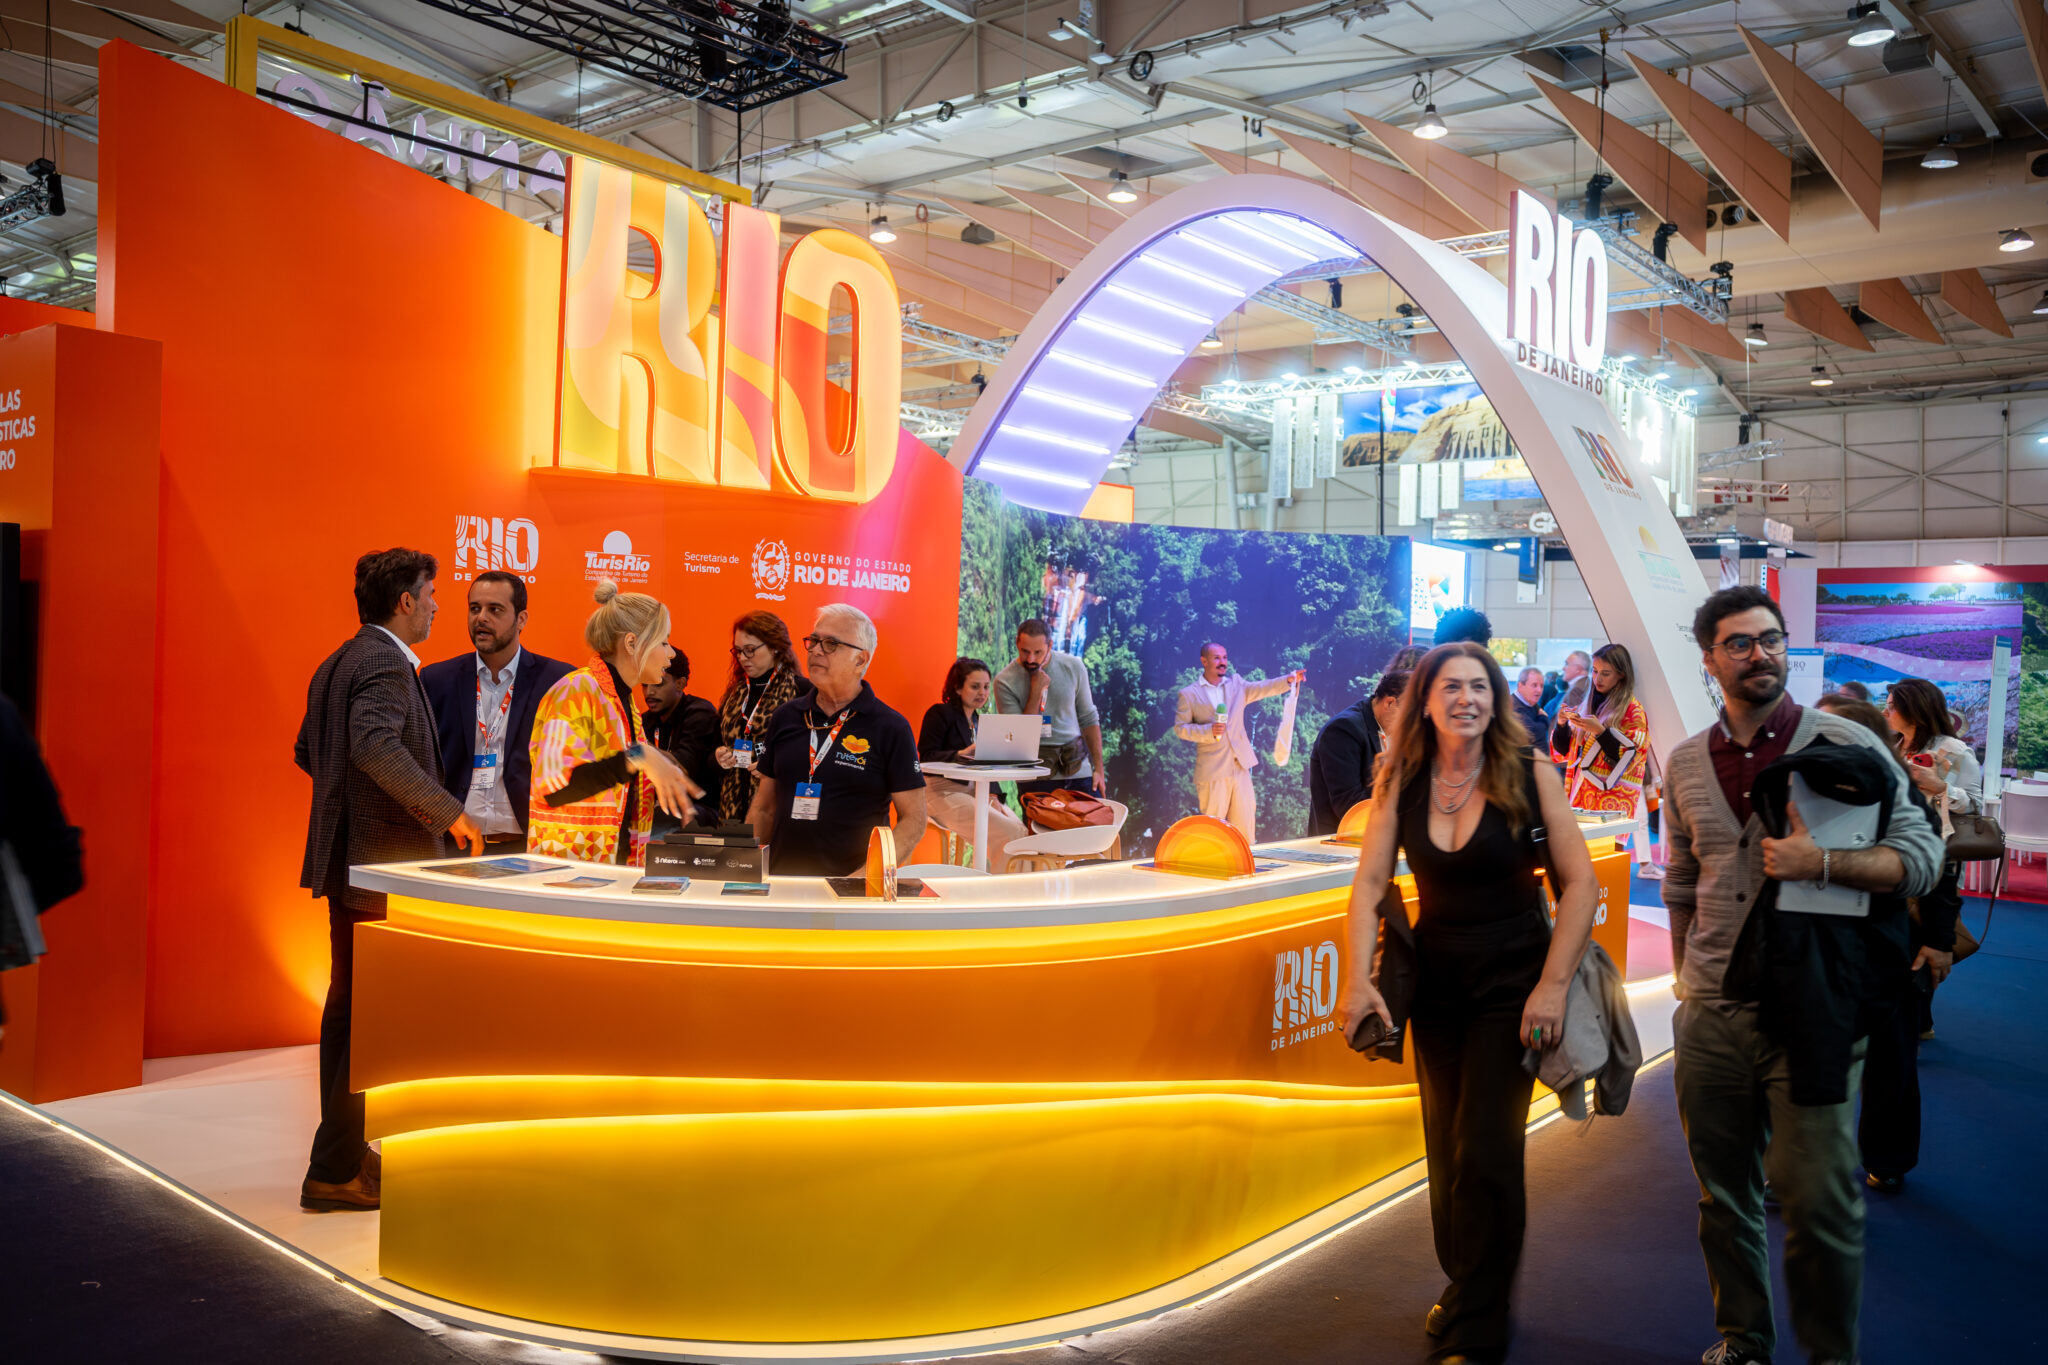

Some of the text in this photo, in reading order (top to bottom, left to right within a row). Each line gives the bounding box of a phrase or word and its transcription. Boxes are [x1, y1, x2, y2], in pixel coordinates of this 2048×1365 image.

[1509, 189, 1609, 373] RIO
[553, 153, 903, 505] RIO
[1518, 343, 1604, 395] DE JANEIRO
[455, 515, 539, 573] RIO
[684, 551, 740, 564] Secretaria de
[454, 572, 472, 582] DE
[585, 552, 650, 572] TurisRio
[684, 562, 721, 574] Turismo
[794, 551, 911, 573] GOVERNO DO ESTADO
[793, 564, 910, 593] RIO DE JANEIRO
[1272, 940, 1339, 1033] RIO
[1270, 1020, 1335, 1051] DE JANEIRO
